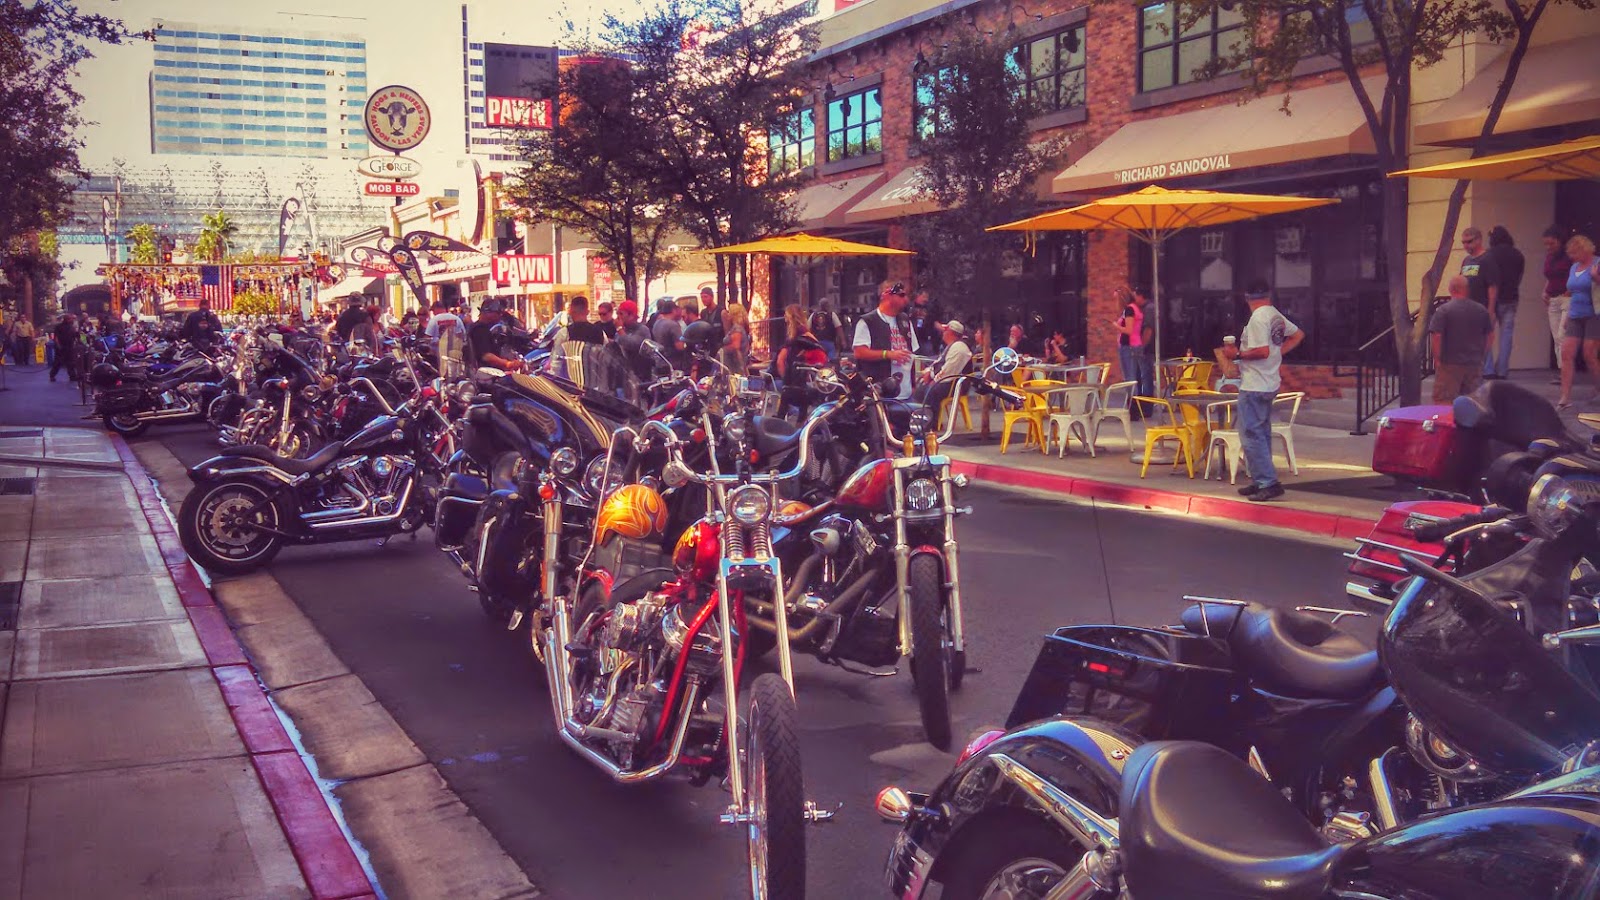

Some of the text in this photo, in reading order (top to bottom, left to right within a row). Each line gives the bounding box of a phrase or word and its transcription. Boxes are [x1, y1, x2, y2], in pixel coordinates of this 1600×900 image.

[372, 94, 388, 112] HOGS
[399, 92, 423, 114] HEIFERS
[488, 98, 546, 126] PAWN
[371, 115, 390, 142] SALOON
[412, 116, 425, 139] VEGAS
[369, 160, 412, 173] GEORGE
[1121, 165, 1166, 183] RICHARD
[1169, 155, 1231, 176] SANDOVAL
[369, 184, 417, 193] MOB BAR
[497, 257, 550, 282] PAWN
